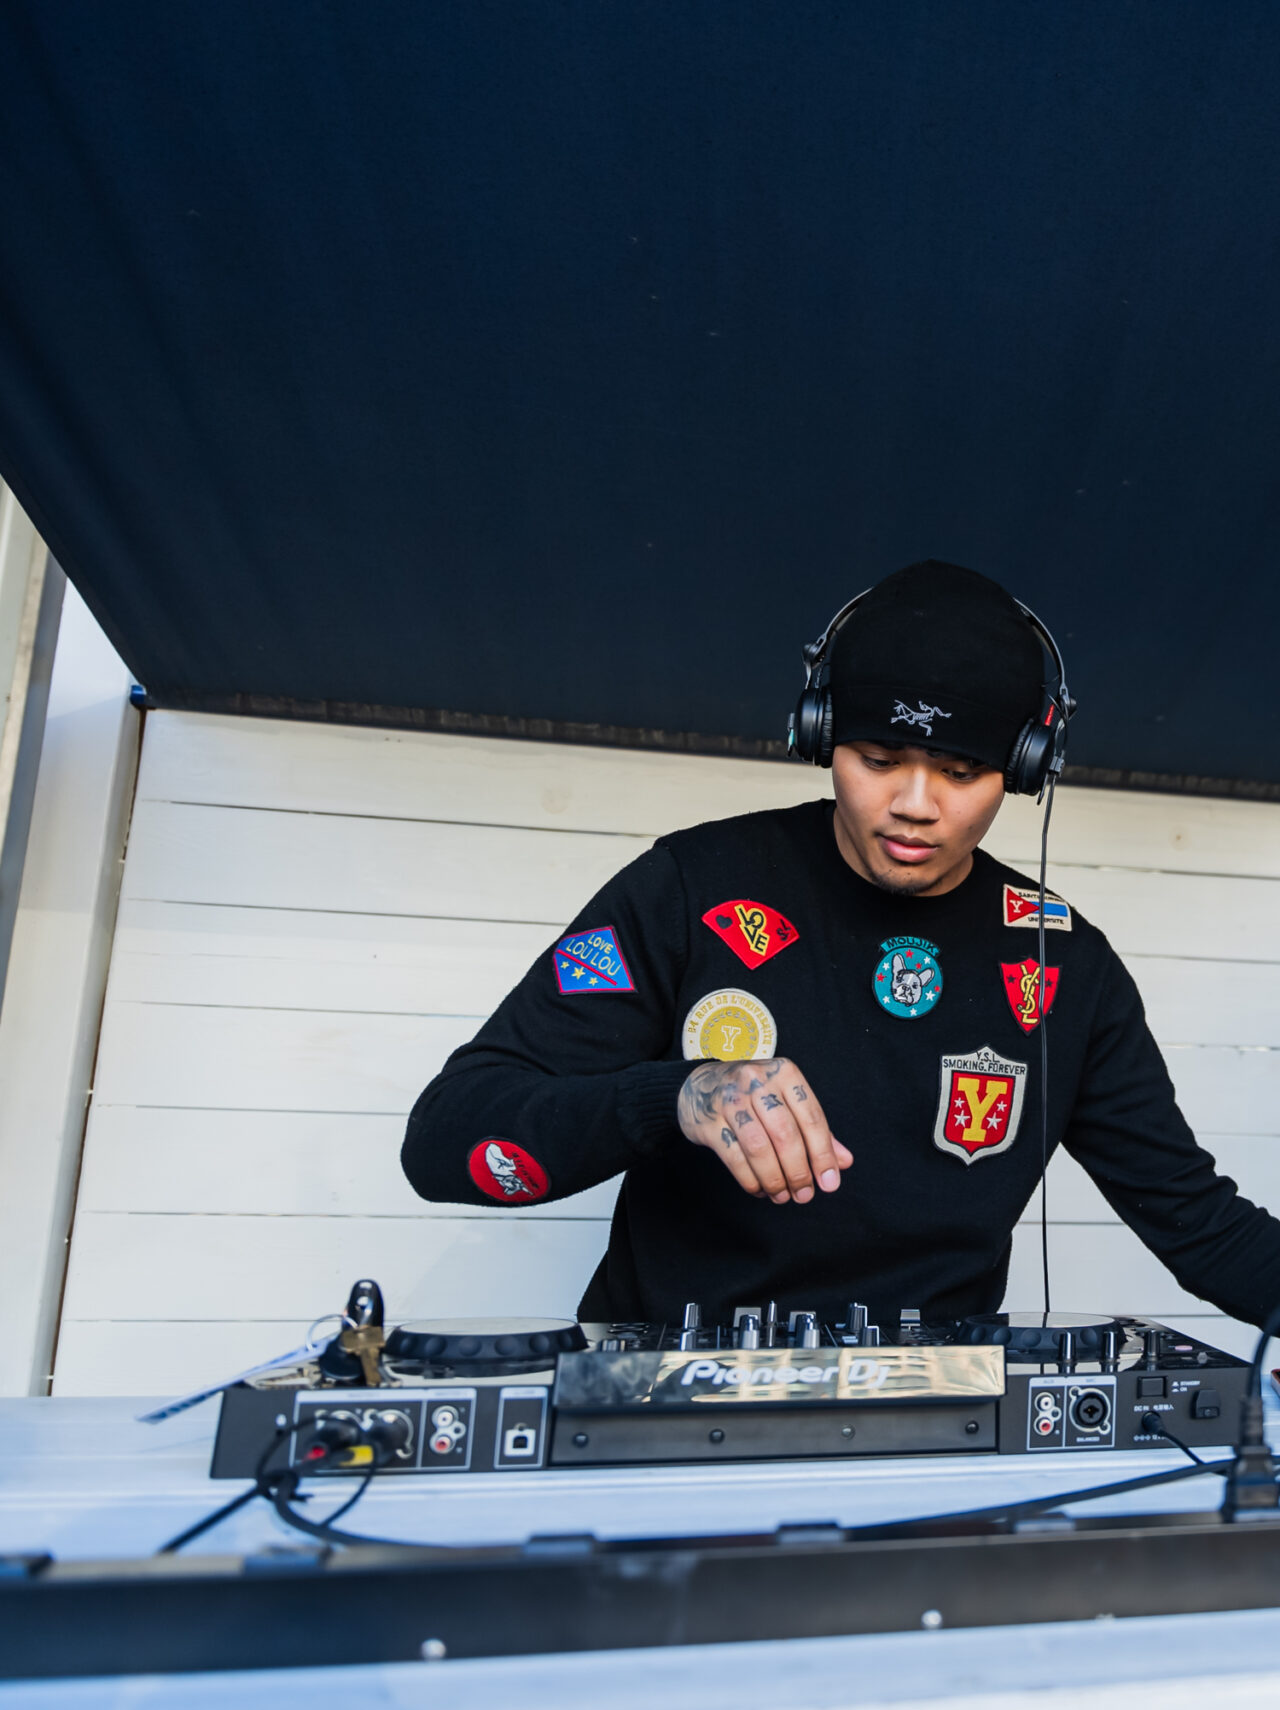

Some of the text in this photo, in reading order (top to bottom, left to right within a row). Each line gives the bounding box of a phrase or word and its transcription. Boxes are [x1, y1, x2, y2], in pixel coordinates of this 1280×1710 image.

[1009, 900, 1024, 913] Y
[1027, 916, 1065, 925] UNIERSITE
[587, 934, 614, 955] LOVE
[886, 936, 937, 954] MOUJIK
[721, 1025, 742, 1052] Y
[988, 1062, 1027, 1076] FOREVER
[957, 1077, 1008, 1142] Y
